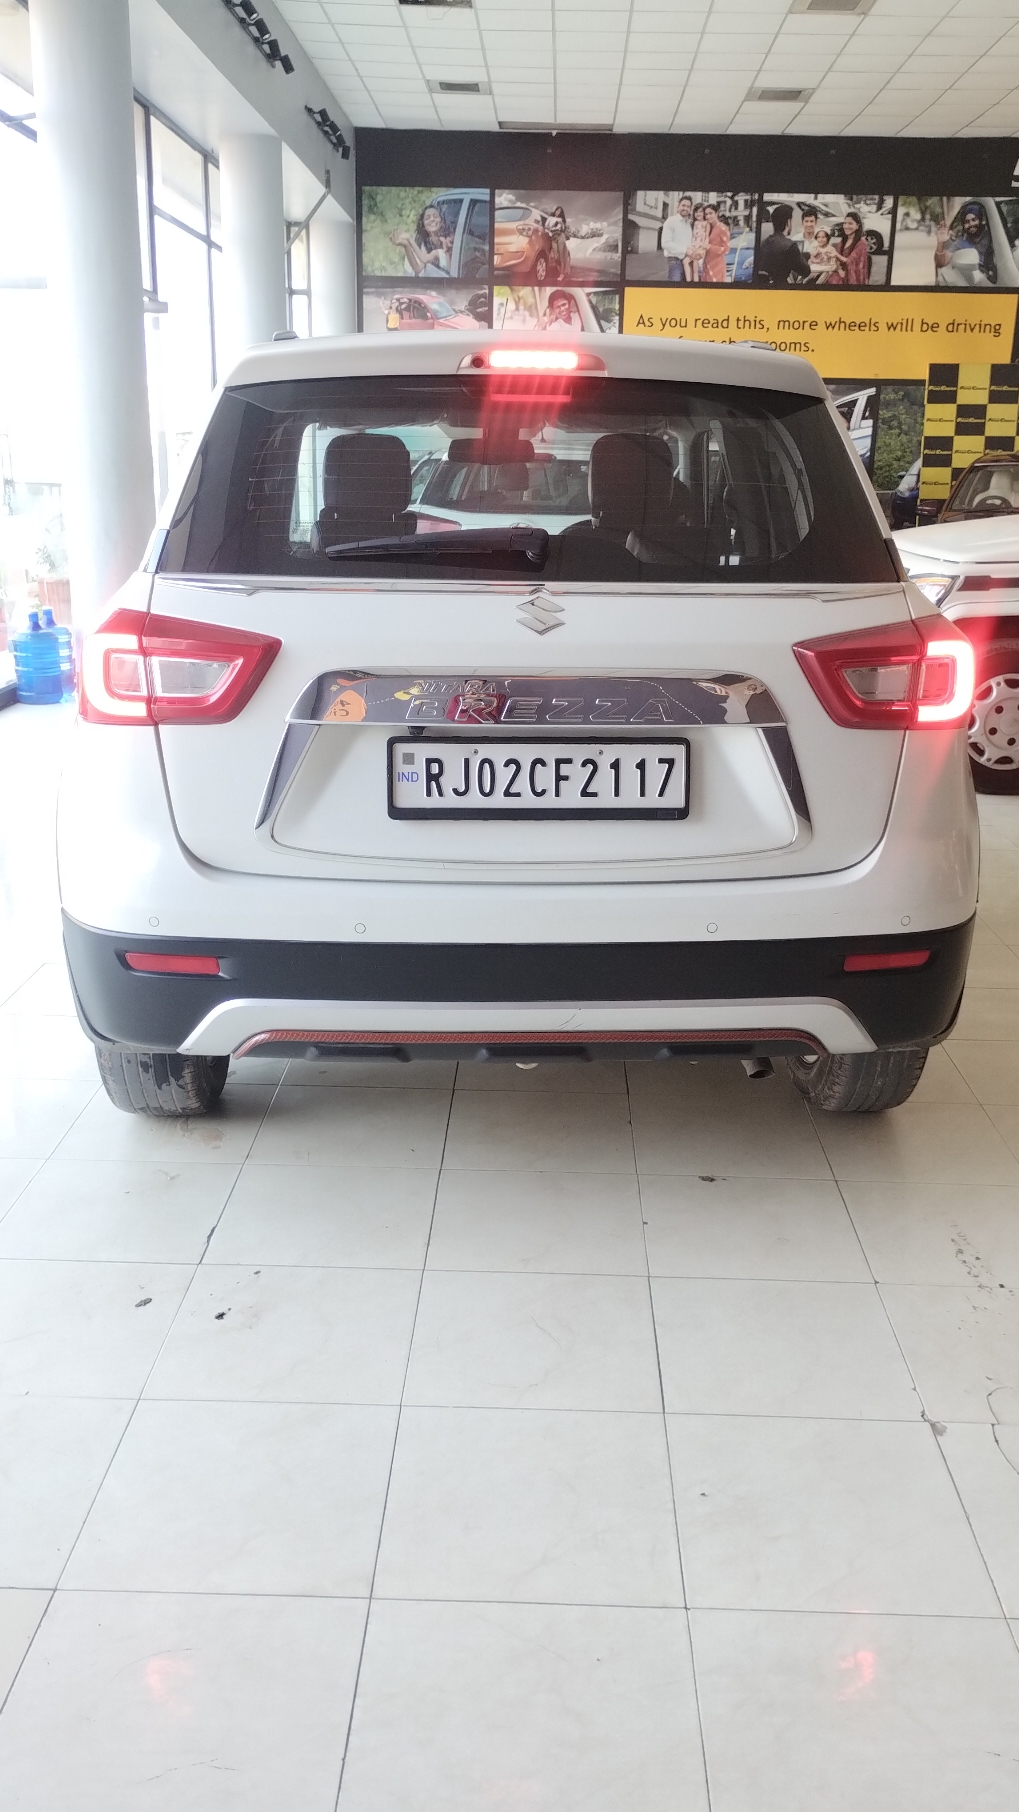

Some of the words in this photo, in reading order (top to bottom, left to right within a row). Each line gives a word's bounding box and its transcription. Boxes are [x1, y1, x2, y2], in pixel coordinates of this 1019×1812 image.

[635, 313, 654, 328] As
[659, 317, 688, 331] you
[694, 315, 730, 329] read
[736, 315, 770, 333] this,
[777, 319, 819, 331] more
[824, 317, 880, 332] wheels
[886, 317, 915, 332] will
[920, 318, 940, 333] be
[945, 319, 1002, 337] driving
[413, 680, 497, 694] VITARA
[405, 697, 675, 724] BREZZA
[397, 771, 420, 783] IND
[424, 757, 676, 798] RJ02CF2117
